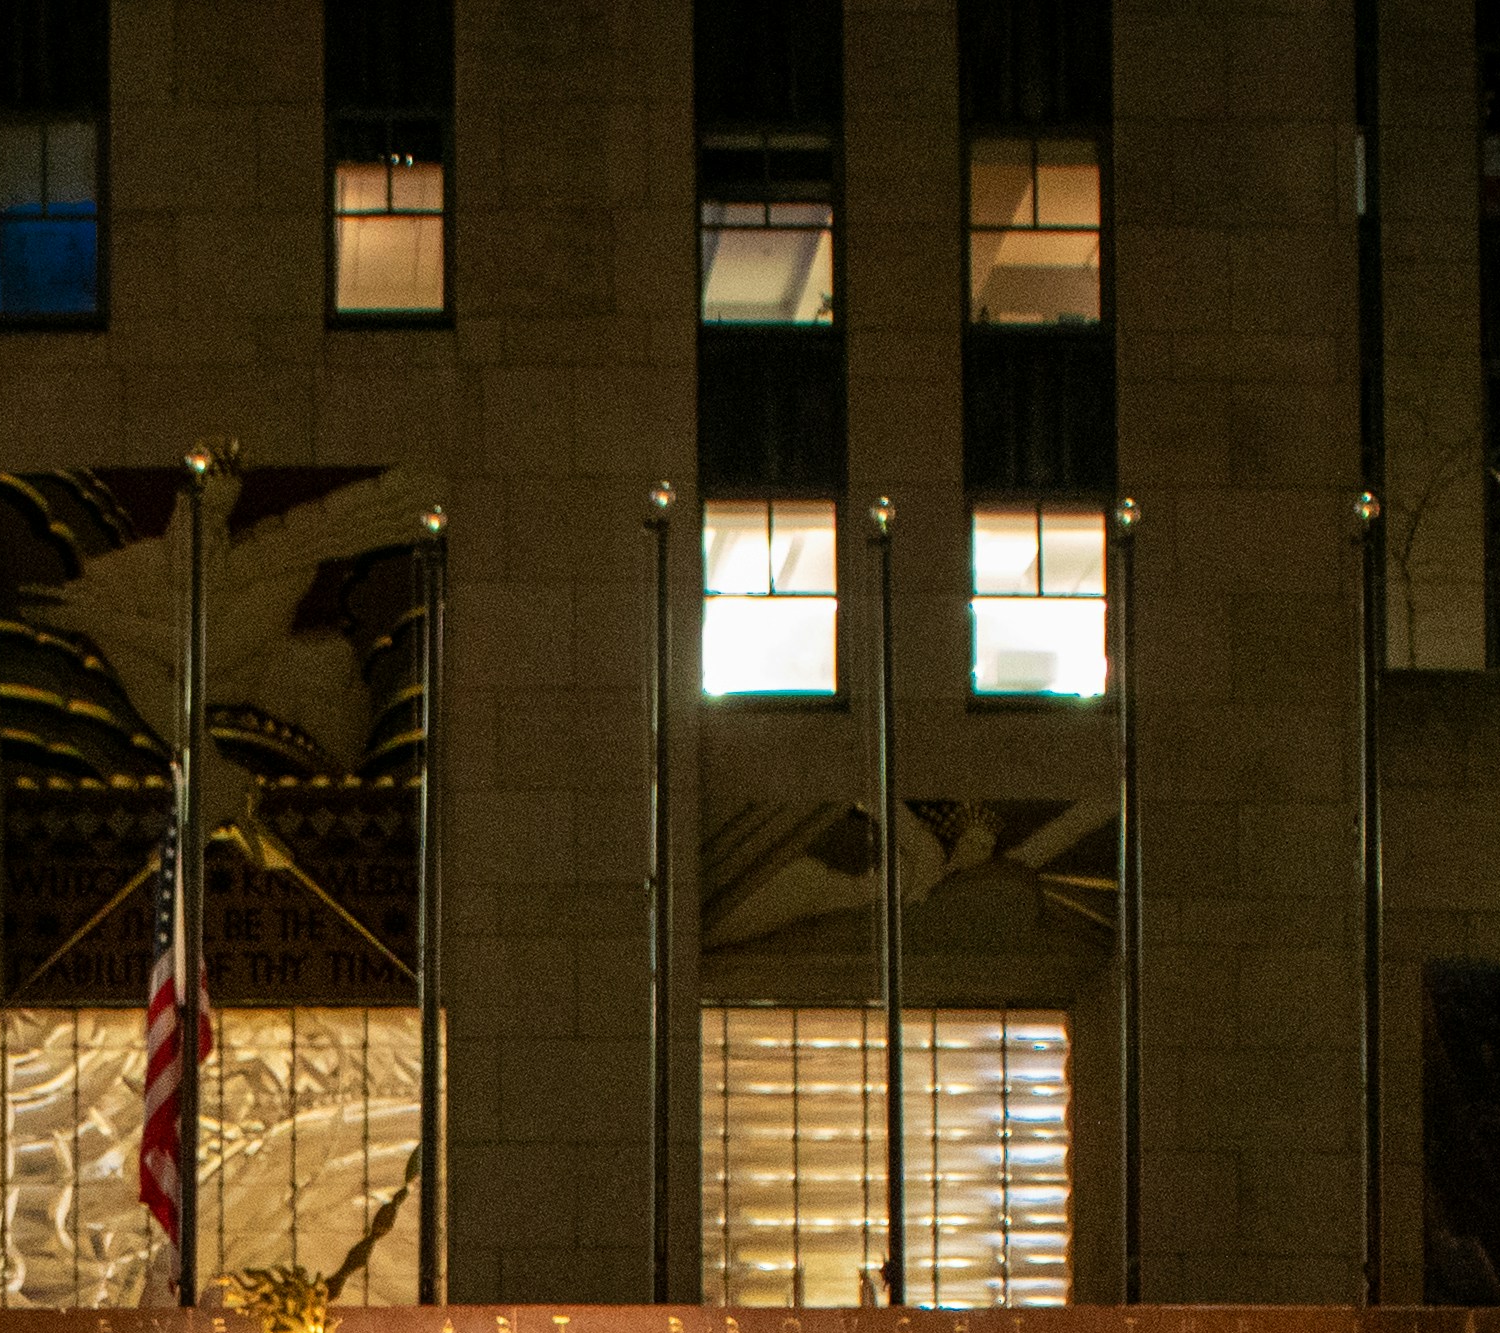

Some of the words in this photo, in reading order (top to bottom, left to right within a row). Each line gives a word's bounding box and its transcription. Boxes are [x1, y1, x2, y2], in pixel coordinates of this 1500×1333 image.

[225, 908, 261, 941] BE
[275, 908, 325, 941] THE
[243, 952, 310, 985] THY
